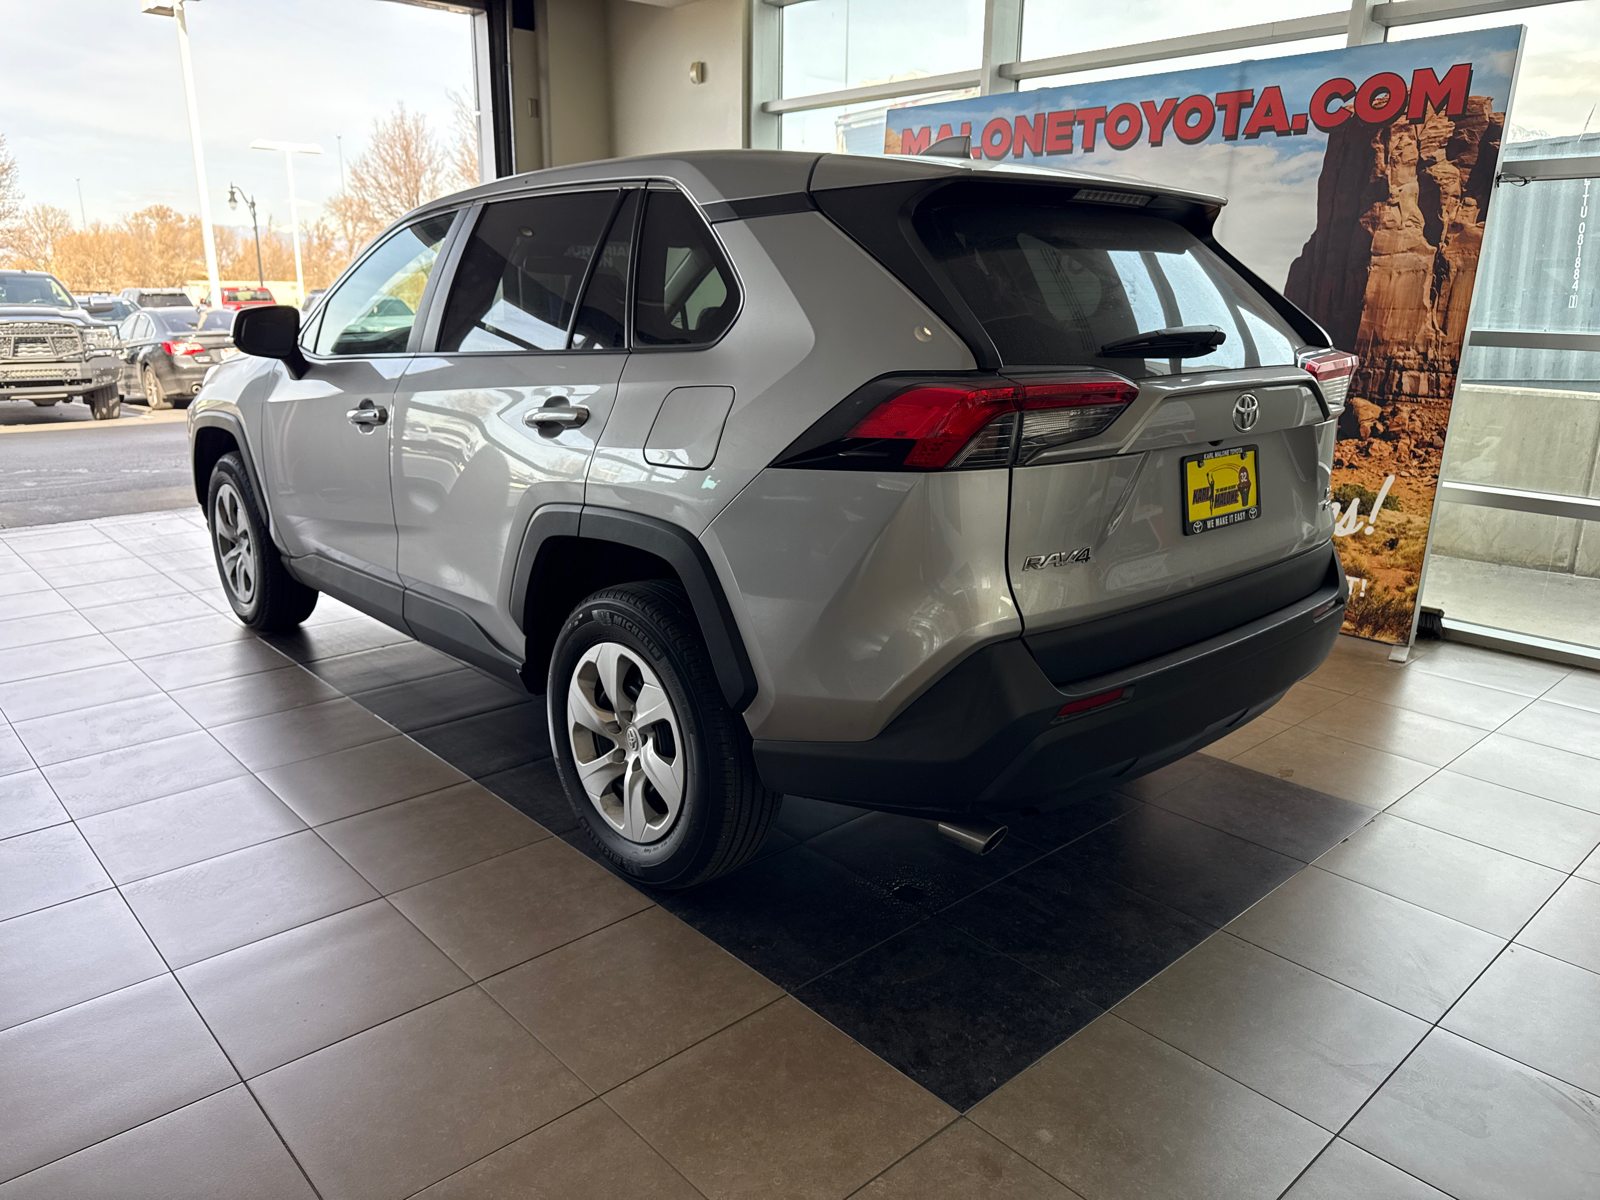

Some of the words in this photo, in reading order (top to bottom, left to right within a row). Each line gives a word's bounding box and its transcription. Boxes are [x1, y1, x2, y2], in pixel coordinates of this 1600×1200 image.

[1571, 222, 1585, 291] 081884
[1240, 472, 1248, 482] 32
[1192, 487, 1210, 505] KARL
[1214, 490, 1239, 509] MALONE
[1207, 520, 1214, 529] WE
[1215, 516, 1228, 527] MAKE
[1229, 514, 1234, 523] IT
[1235, 511, 1246, 522] EASY
[1022, 546, 1091, 571] RAV4
[613, 615, 661, 659] MICHELIN
